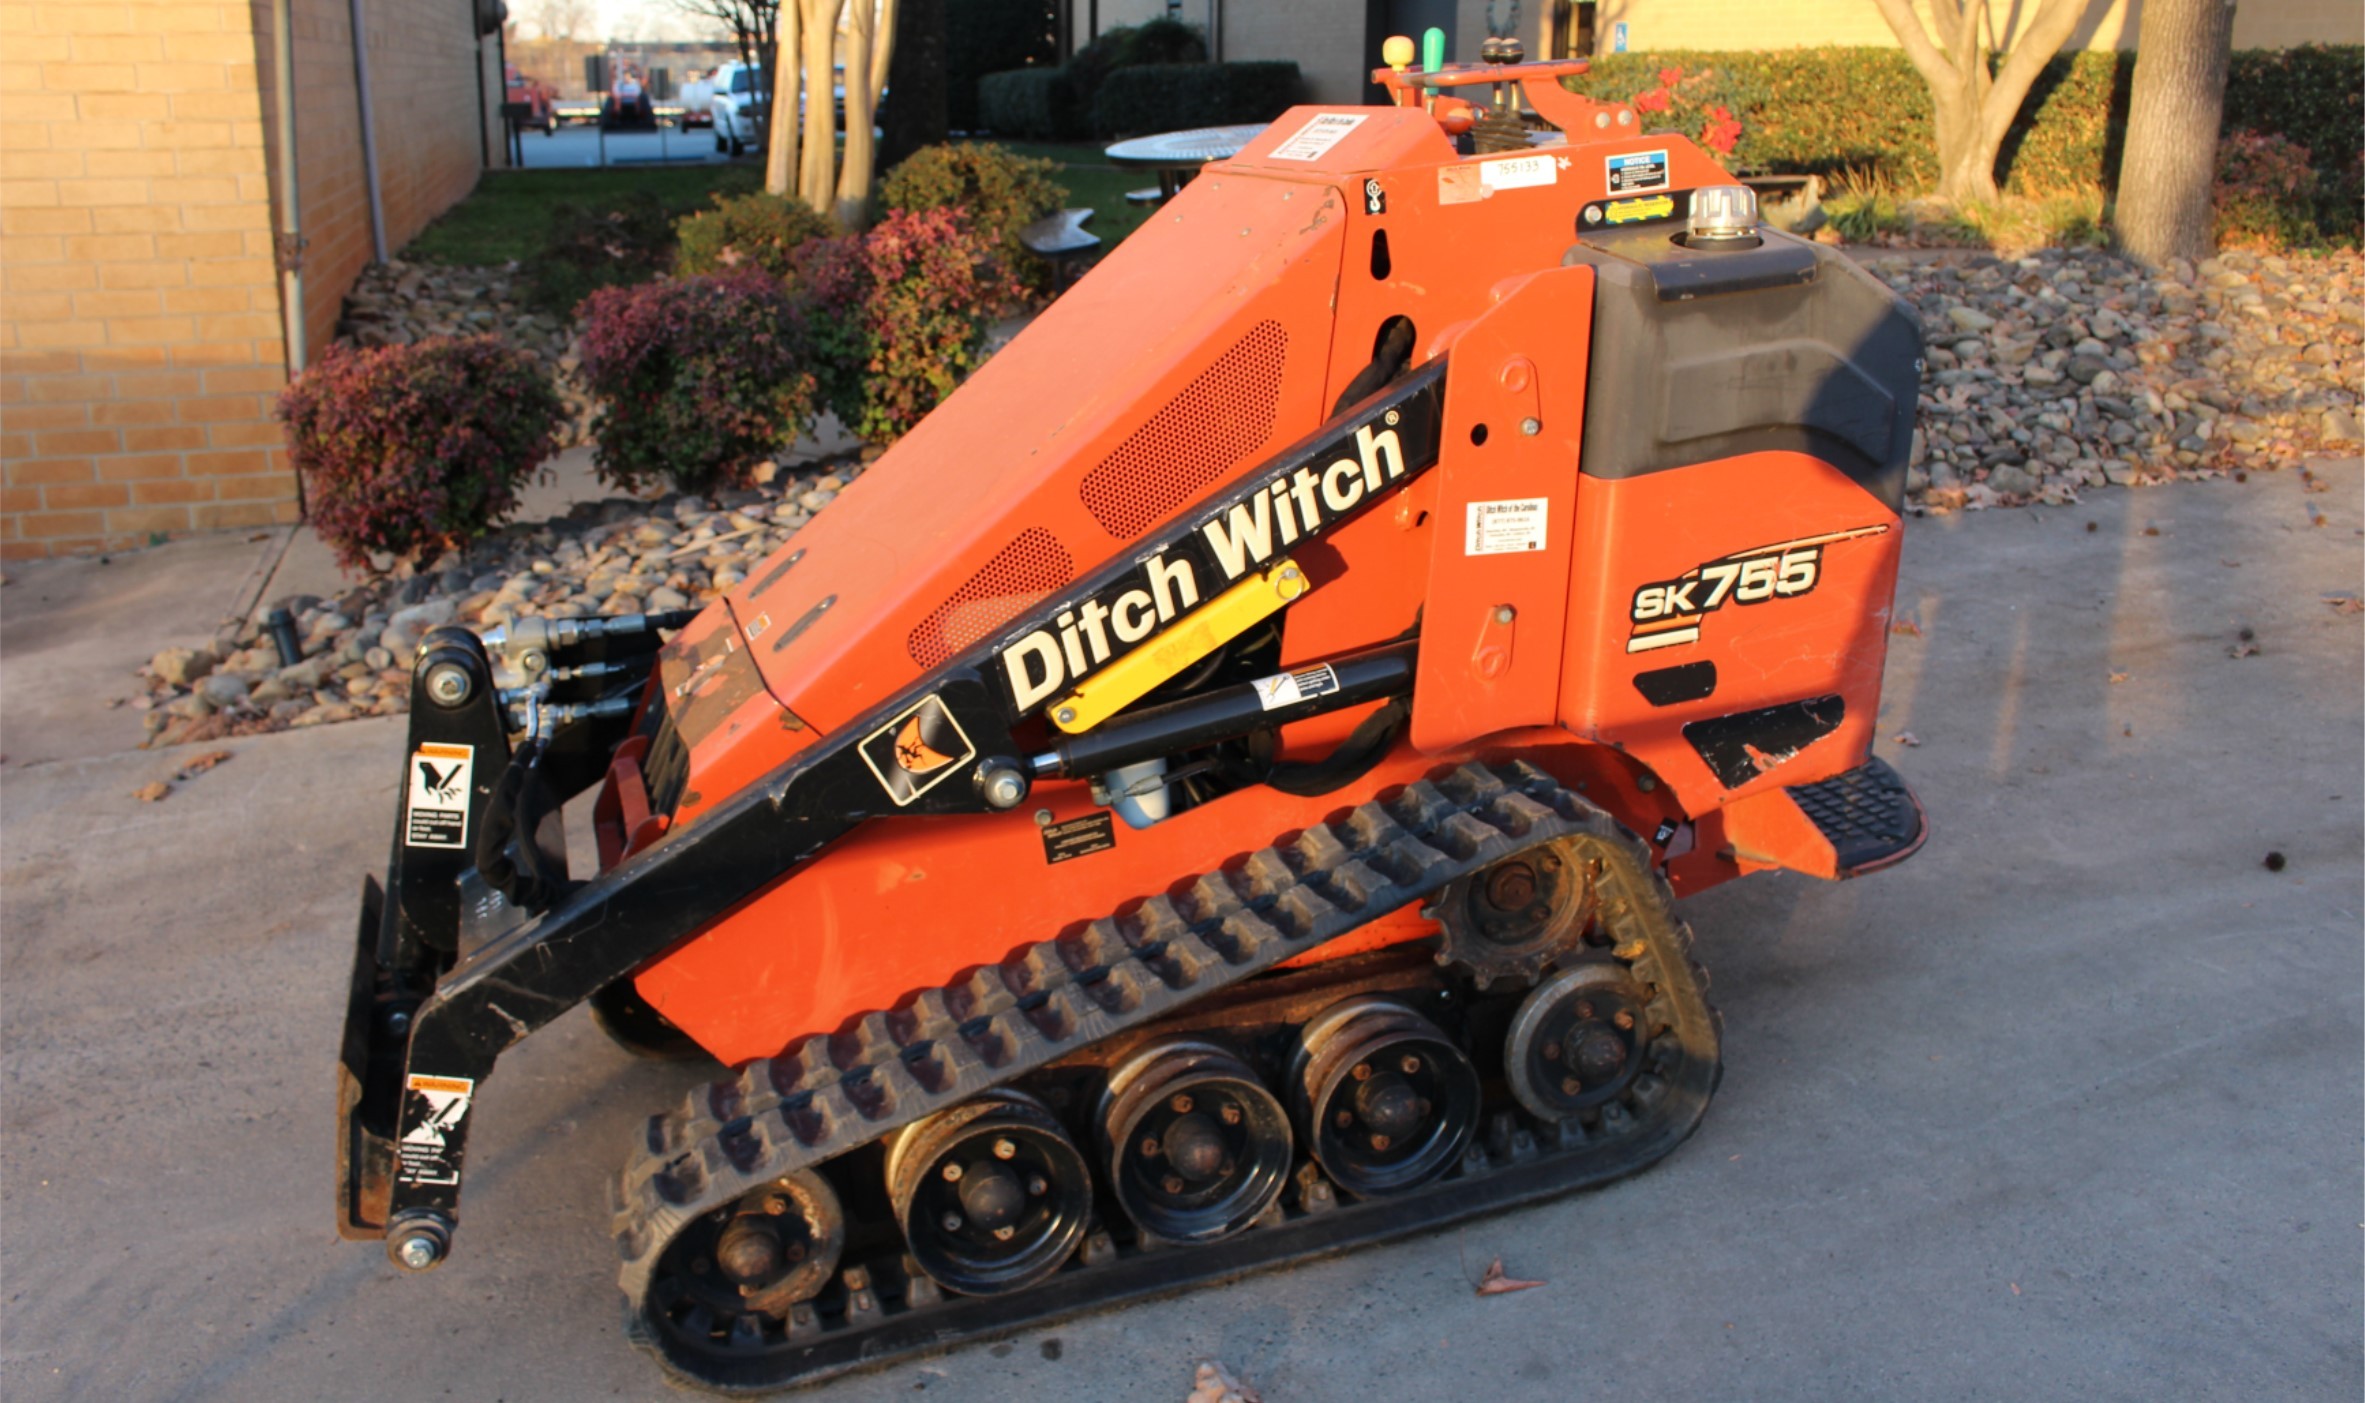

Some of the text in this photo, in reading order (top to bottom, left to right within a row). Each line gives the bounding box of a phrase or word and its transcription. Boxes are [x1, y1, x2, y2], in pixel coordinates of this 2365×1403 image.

[1497, 159, 1540, 176] 755133
[1624, 155, 1651, 167] NOTICE
[1002, 424, 1405, 713] Ditch Witch
